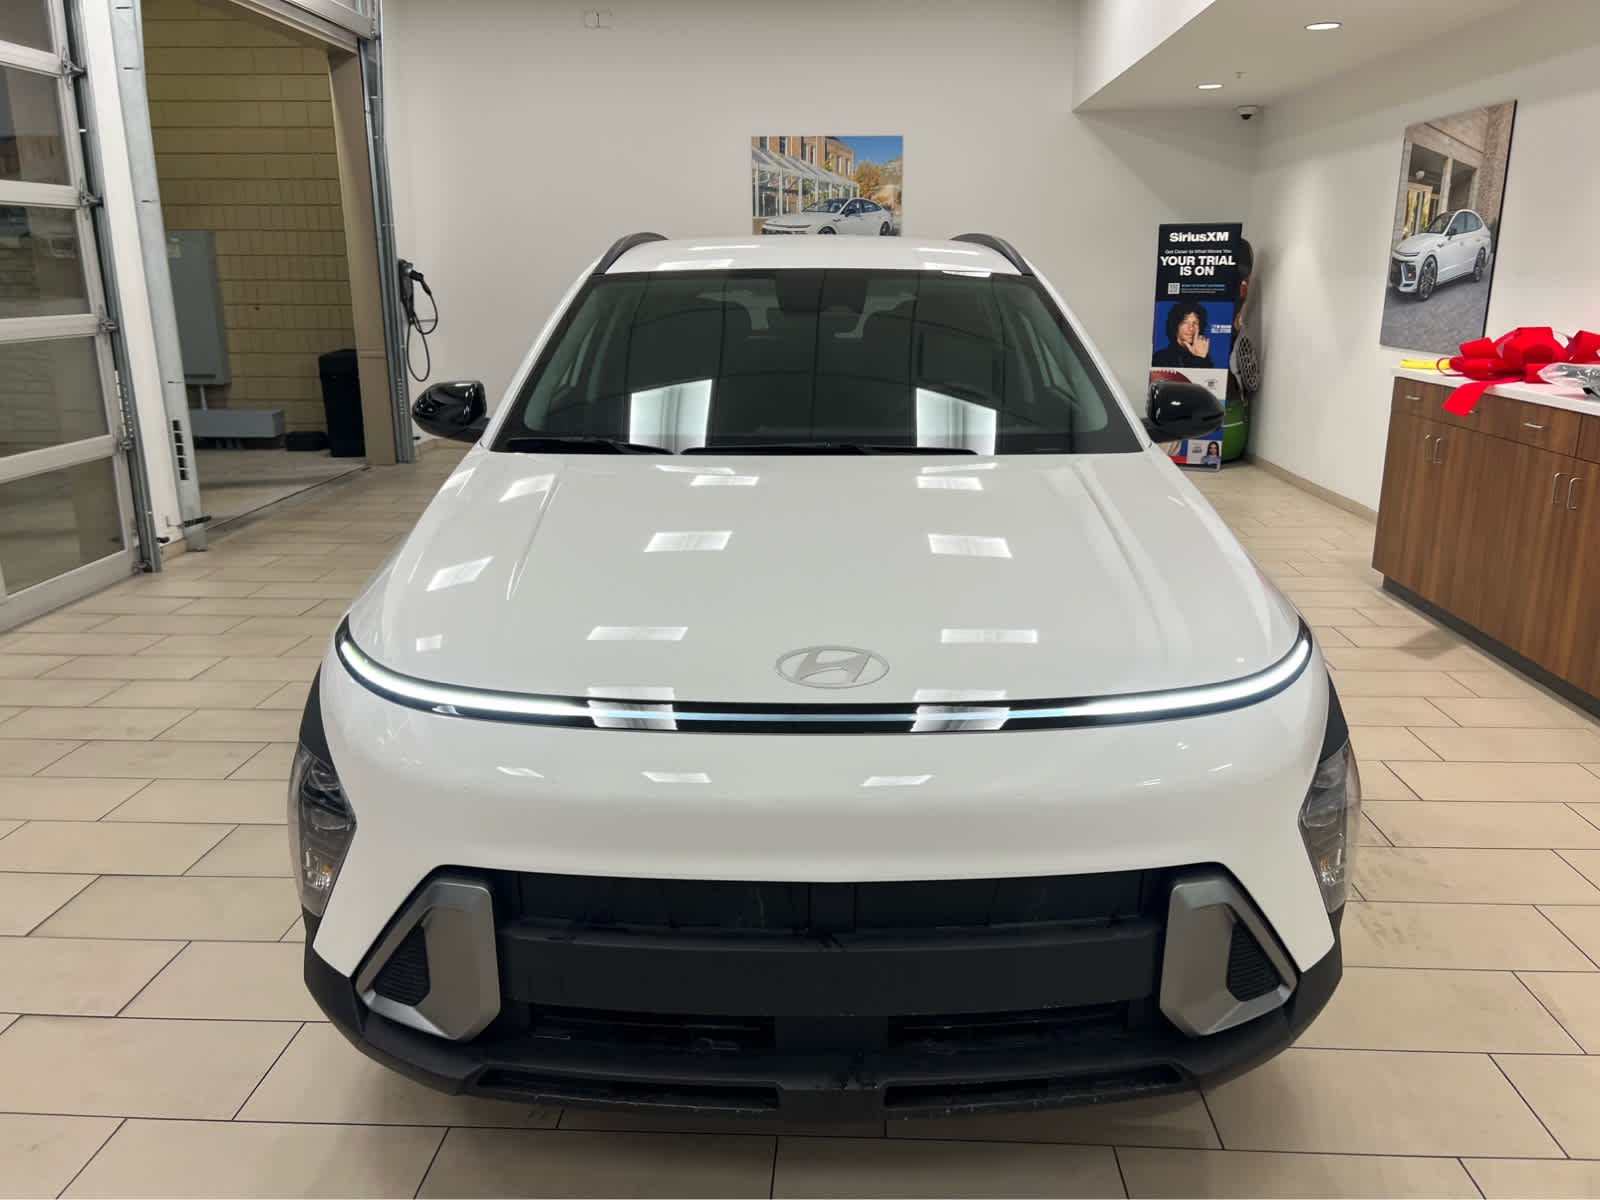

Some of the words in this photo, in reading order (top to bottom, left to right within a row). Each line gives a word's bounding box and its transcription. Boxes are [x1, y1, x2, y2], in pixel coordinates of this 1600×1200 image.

[1169, 231, 1229, 242] SiriusXM
[1160, 255, 1196, 266] YOUR
[1198, 255, 1236, 266] TRIAL
[1179, 266, 1192, 276] IS
[1194, 266, 1215, 276] ON
